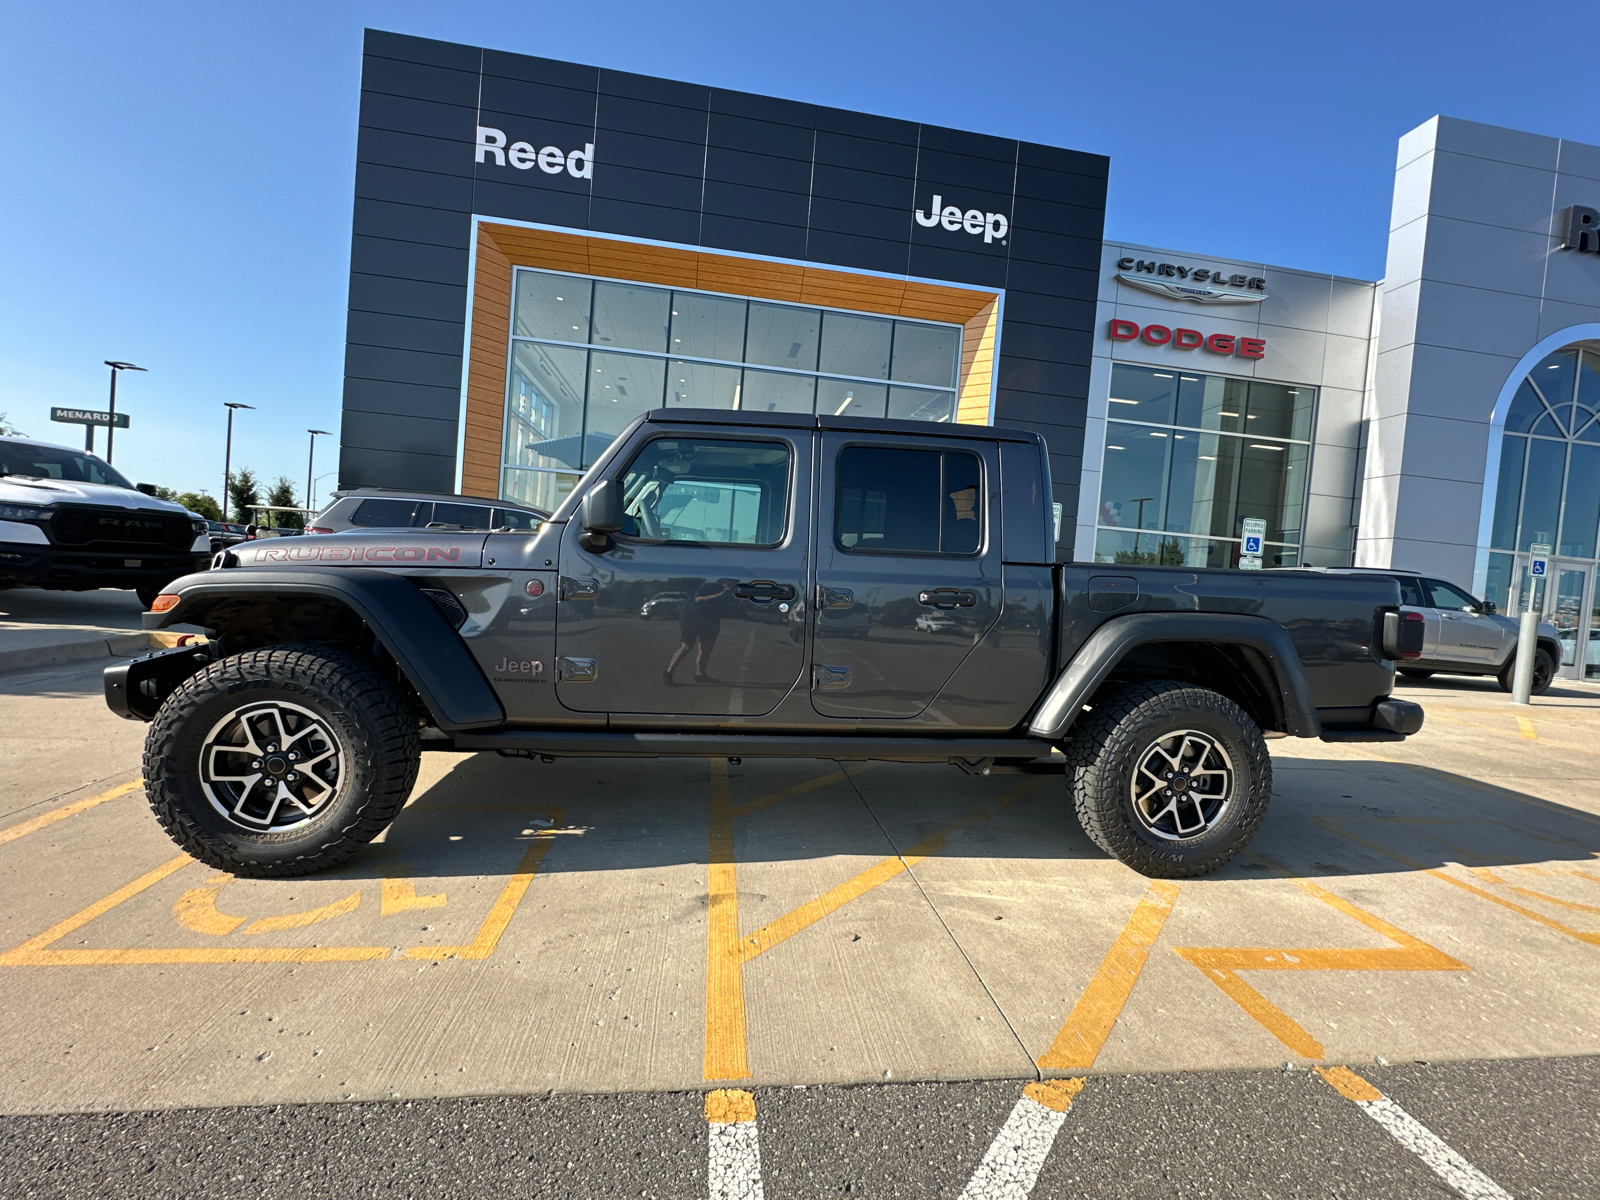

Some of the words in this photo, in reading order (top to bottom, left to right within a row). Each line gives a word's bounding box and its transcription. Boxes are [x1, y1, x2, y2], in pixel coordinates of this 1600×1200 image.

[476, 126, 594, 180] Reed
[915, 194, 1008, 243] Jeep
[1117, 257, 1266, 290] CHRYSLER
[1109, 318, 1266, 360] DODGE
[99, 518, 163, 528] RAM
[1245, 521, 1264, 529] RESERVED
[254, 547, 461, 563] RUBICON
[494, 656, 544, 677] Jeep
